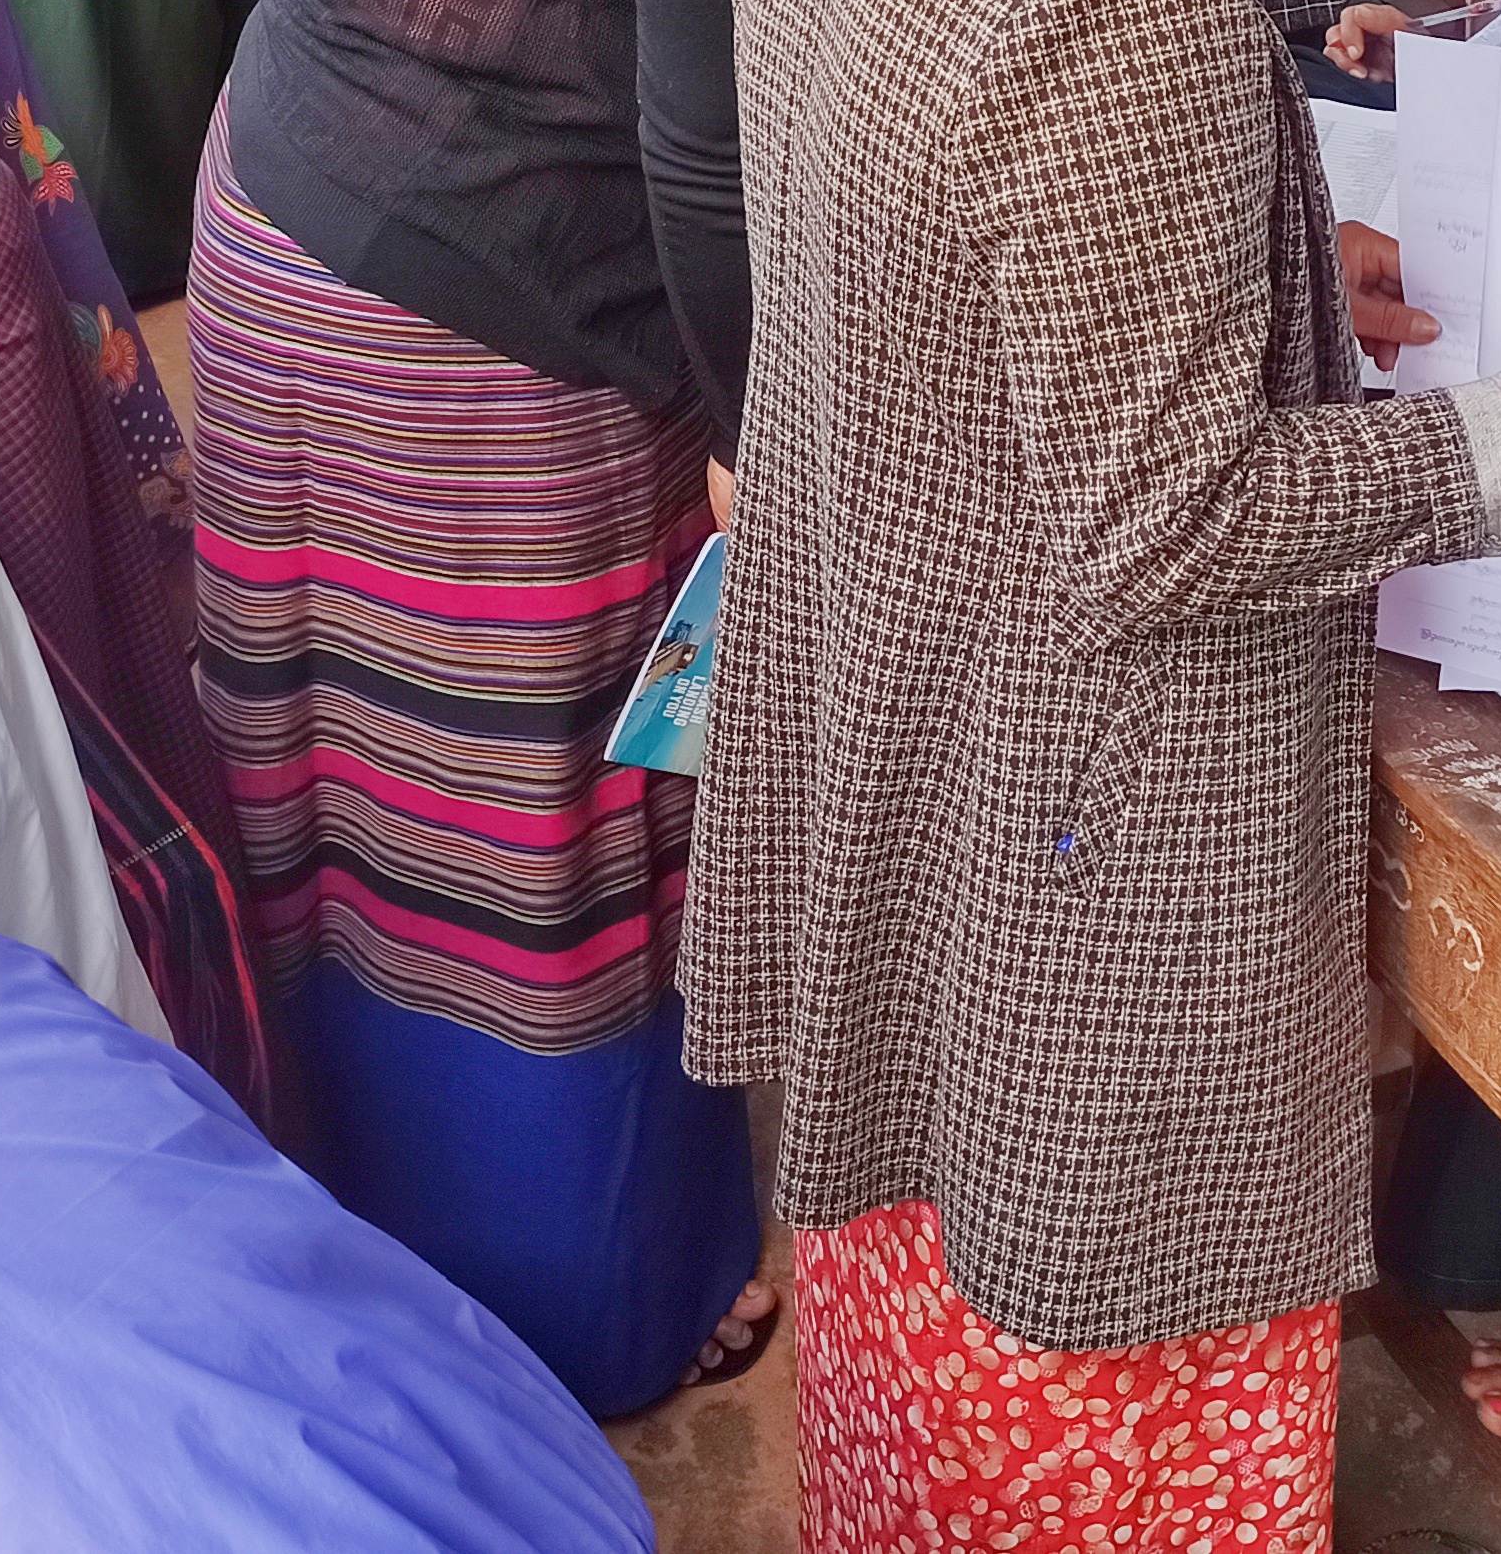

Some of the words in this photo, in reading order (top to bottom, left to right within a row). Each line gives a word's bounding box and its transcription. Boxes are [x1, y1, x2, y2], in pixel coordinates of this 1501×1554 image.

[672, 677, 691, 694] ON
[662, 695, 684, 718] YOU
[673, 675, 707, 727] LANDING
